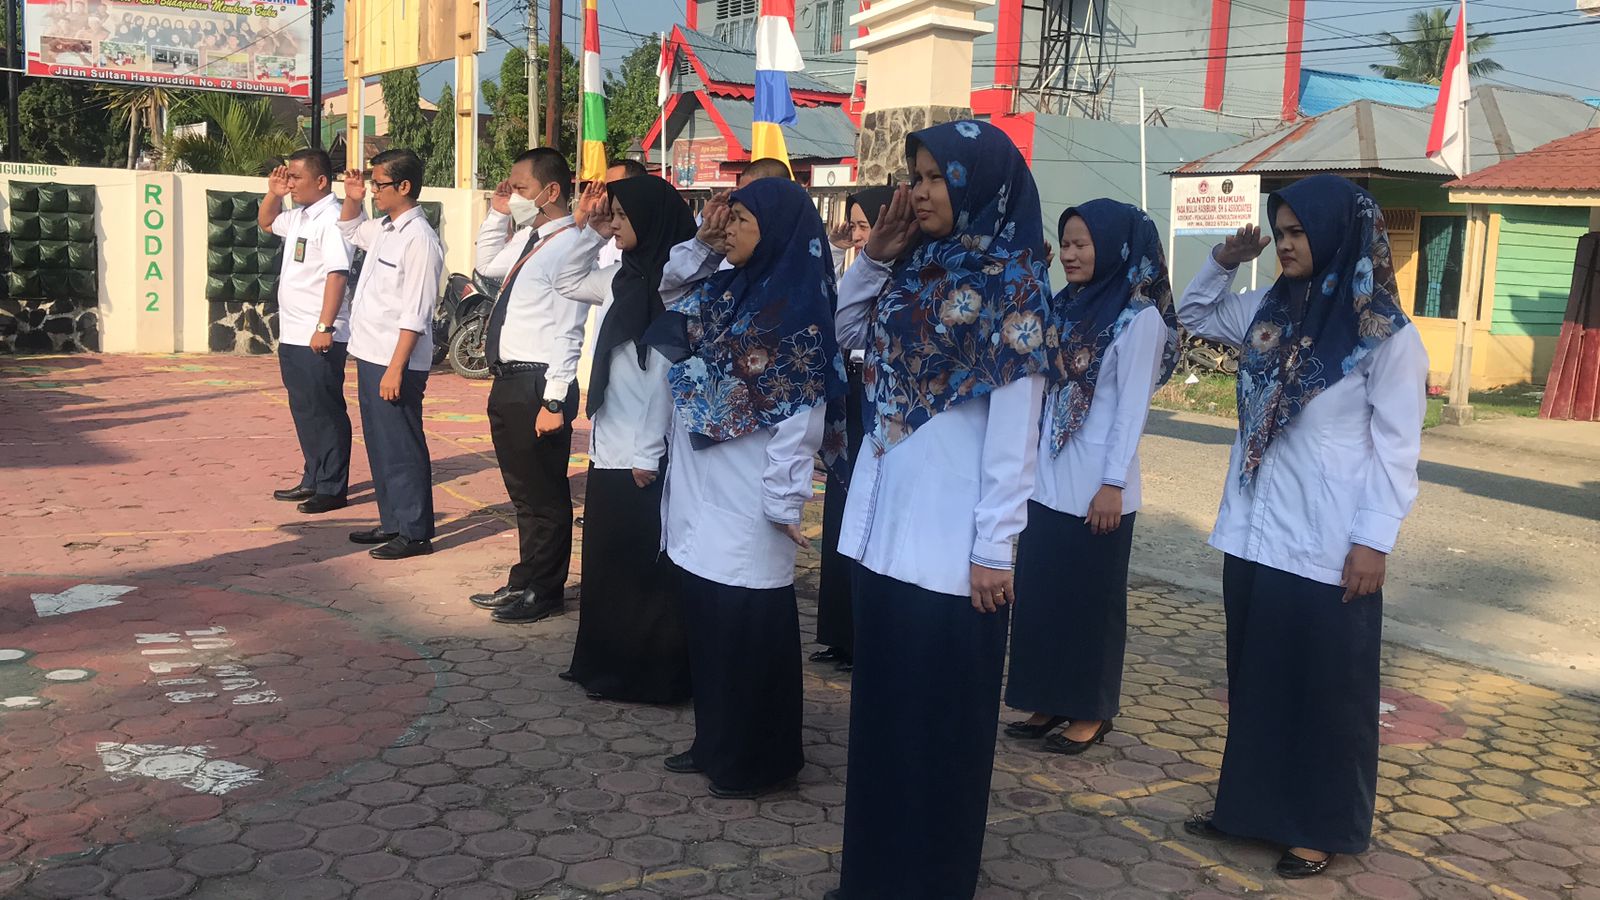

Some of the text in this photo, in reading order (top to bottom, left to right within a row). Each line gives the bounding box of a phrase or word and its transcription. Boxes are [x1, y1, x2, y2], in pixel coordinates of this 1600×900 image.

[211, 1, 252, 16] Membaca
[255, 4, 278, 18] Buku
[55, 66, 284, 93] Jalan Sultan Hasanuddin No. 02 Sibuhuan
[1187, 195, 1245, 204] KANTOR HUKUM
[143, 183, 164, 312] RODA 2
[185, 625, 282, 706] KUMUL
